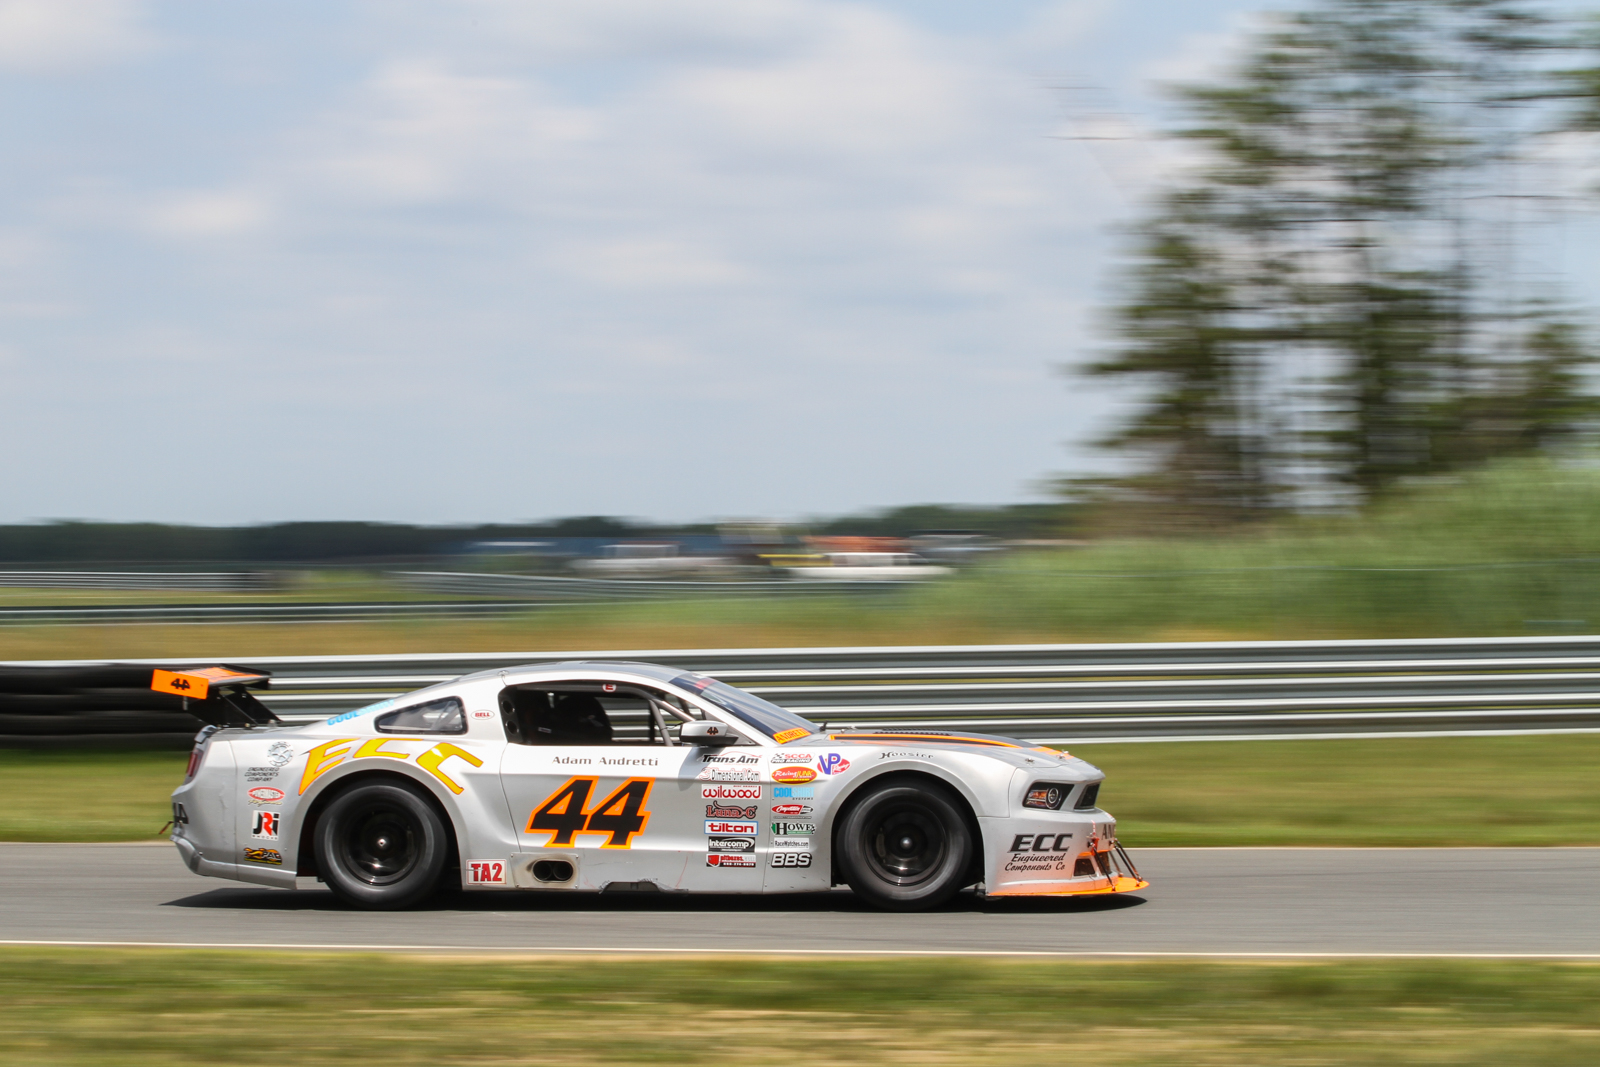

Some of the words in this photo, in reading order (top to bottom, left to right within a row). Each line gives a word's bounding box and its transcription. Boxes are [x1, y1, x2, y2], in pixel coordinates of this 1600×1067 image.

[170, 677, 191, 691] 44
[702, 754, 736, 763] Trans
[737, 755, 760, 764] Am
[879, 751, 934, 759] Hoosier
[298, 738, 484, 796] ECC
[552, 756, 592, 765] Adam
[599, 756, 659, 767] Andretti
[819, 753, 841, 775] VP
[702, 785, 761, 799] wilwood
[524, 775, 656, 849] 44
[708, 822, 754, 833] tilton
[709, 839, 750, 849] Intercomp
[774, 839, 809, 847] RaceWatches.com
[1008, 834, 1073, 853] ECC
[771, 853, 812, 868] BBS
[1011, 853, 1066, 864] Engineered
[471, 863, 502, 882] TA2
[1004, 863, 1052, 872] Components
[1055, 862, 1066, 870] Co
